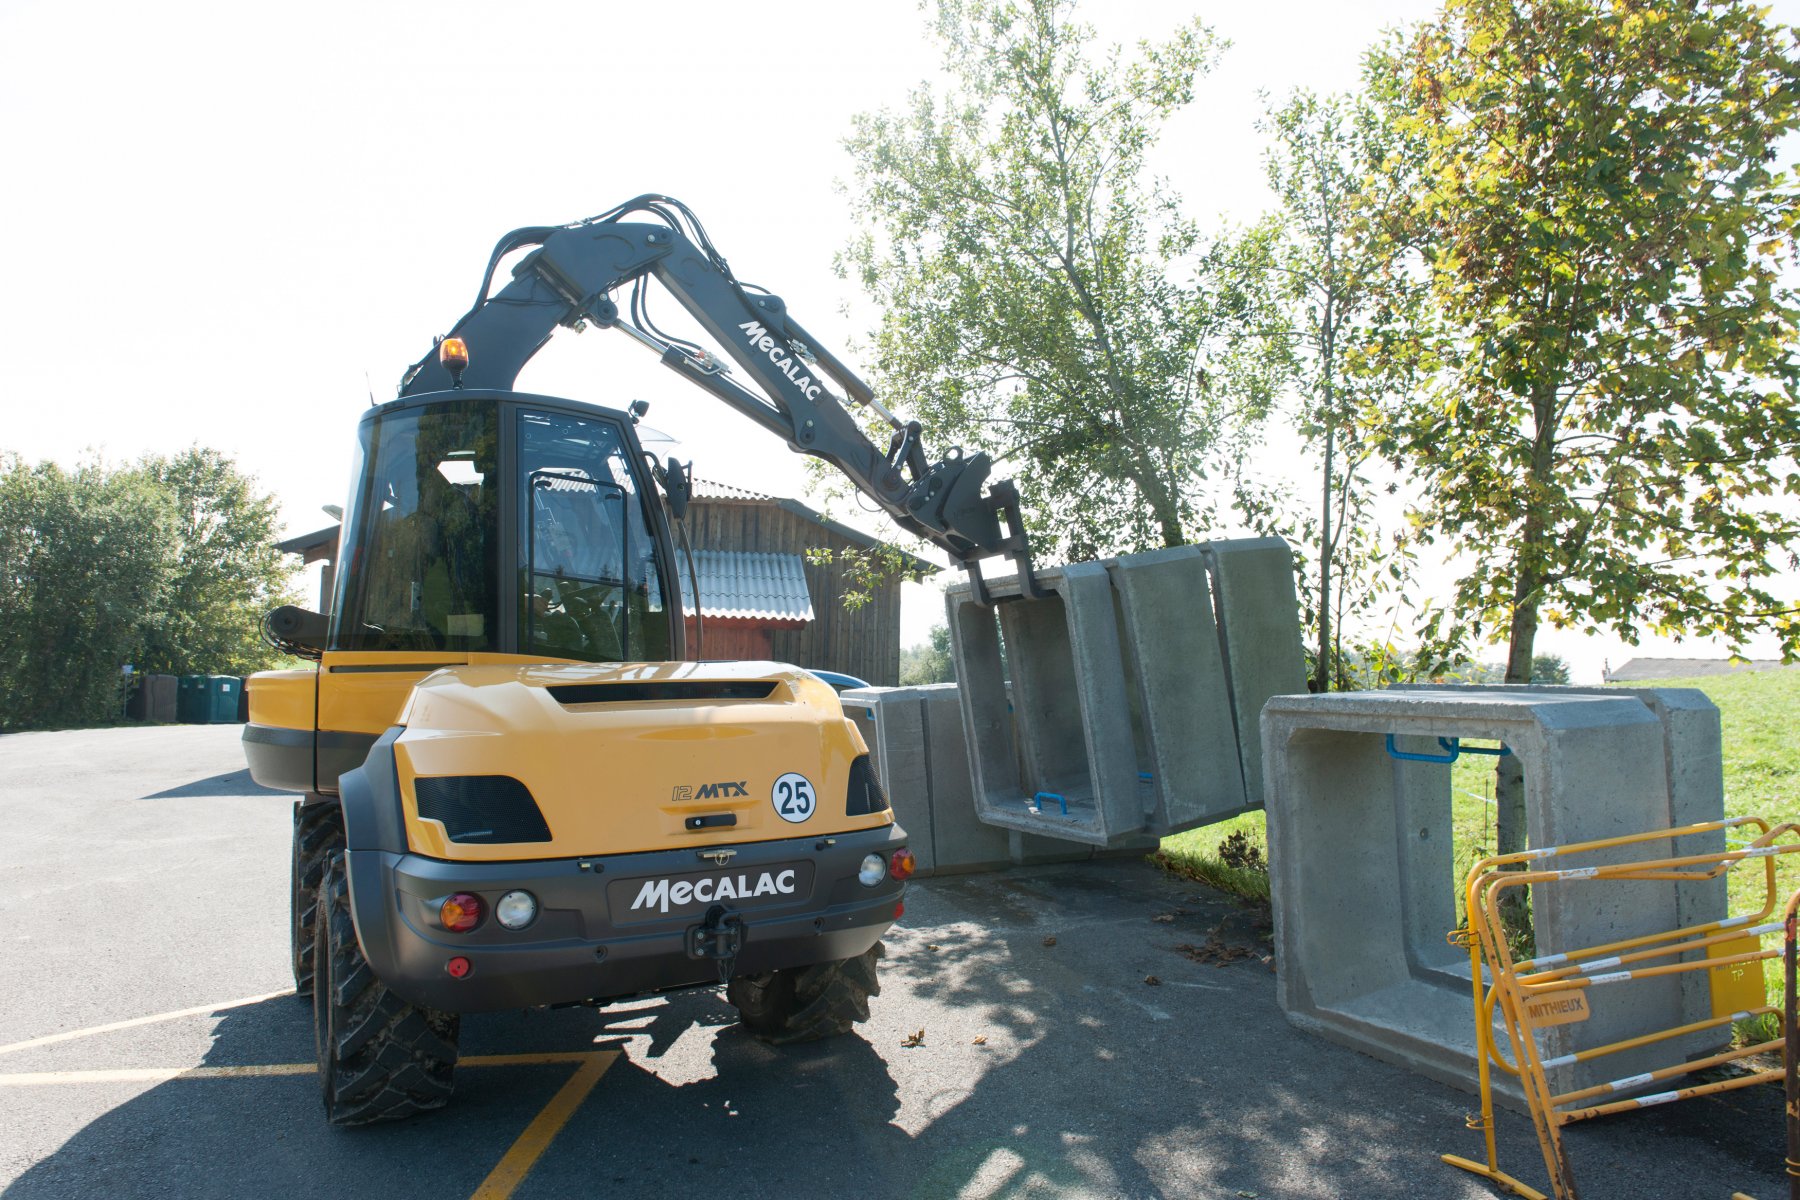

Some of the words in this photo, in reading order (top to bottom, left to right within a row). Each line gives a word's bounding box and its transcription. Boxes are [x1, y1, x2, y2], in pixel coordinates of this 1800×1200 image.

[671, 785, 693, 802] 12
[694, 780, 750, 800] MTX
[778, 781, 811, 815] 25
[1528, 998, 1584, 1019] MITHIEUX
